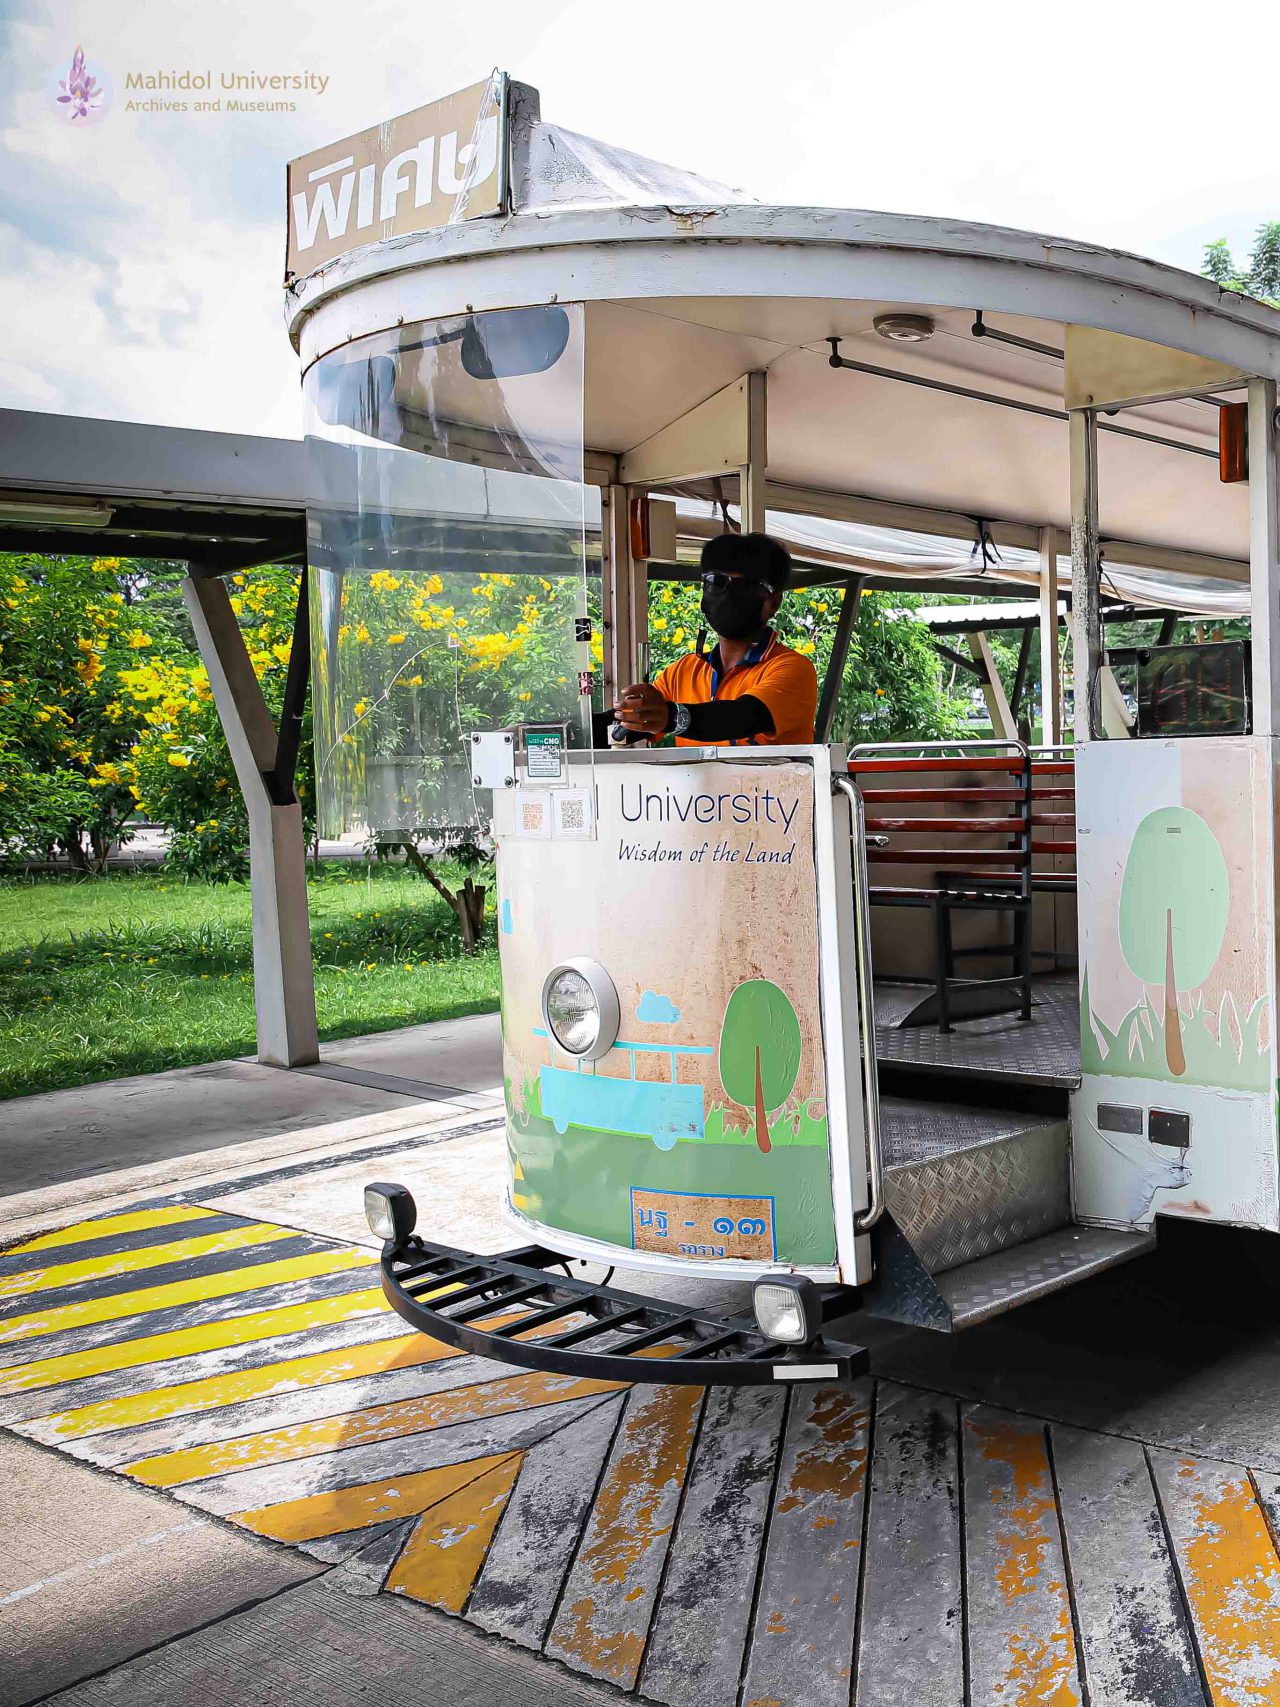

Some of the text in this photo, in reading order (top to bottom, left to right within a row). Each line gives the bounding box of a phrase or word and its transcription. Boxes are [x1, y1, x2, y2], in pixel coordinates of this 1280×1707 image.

[292, 115, 499, 252] พิเศษ
[543, 737, 560, 745] CNG
[620, 783, 799, 835] University
[618, 839, 796, 864] Wisdom of the Land
[713, 1217, 767, 1236] ๑๓
